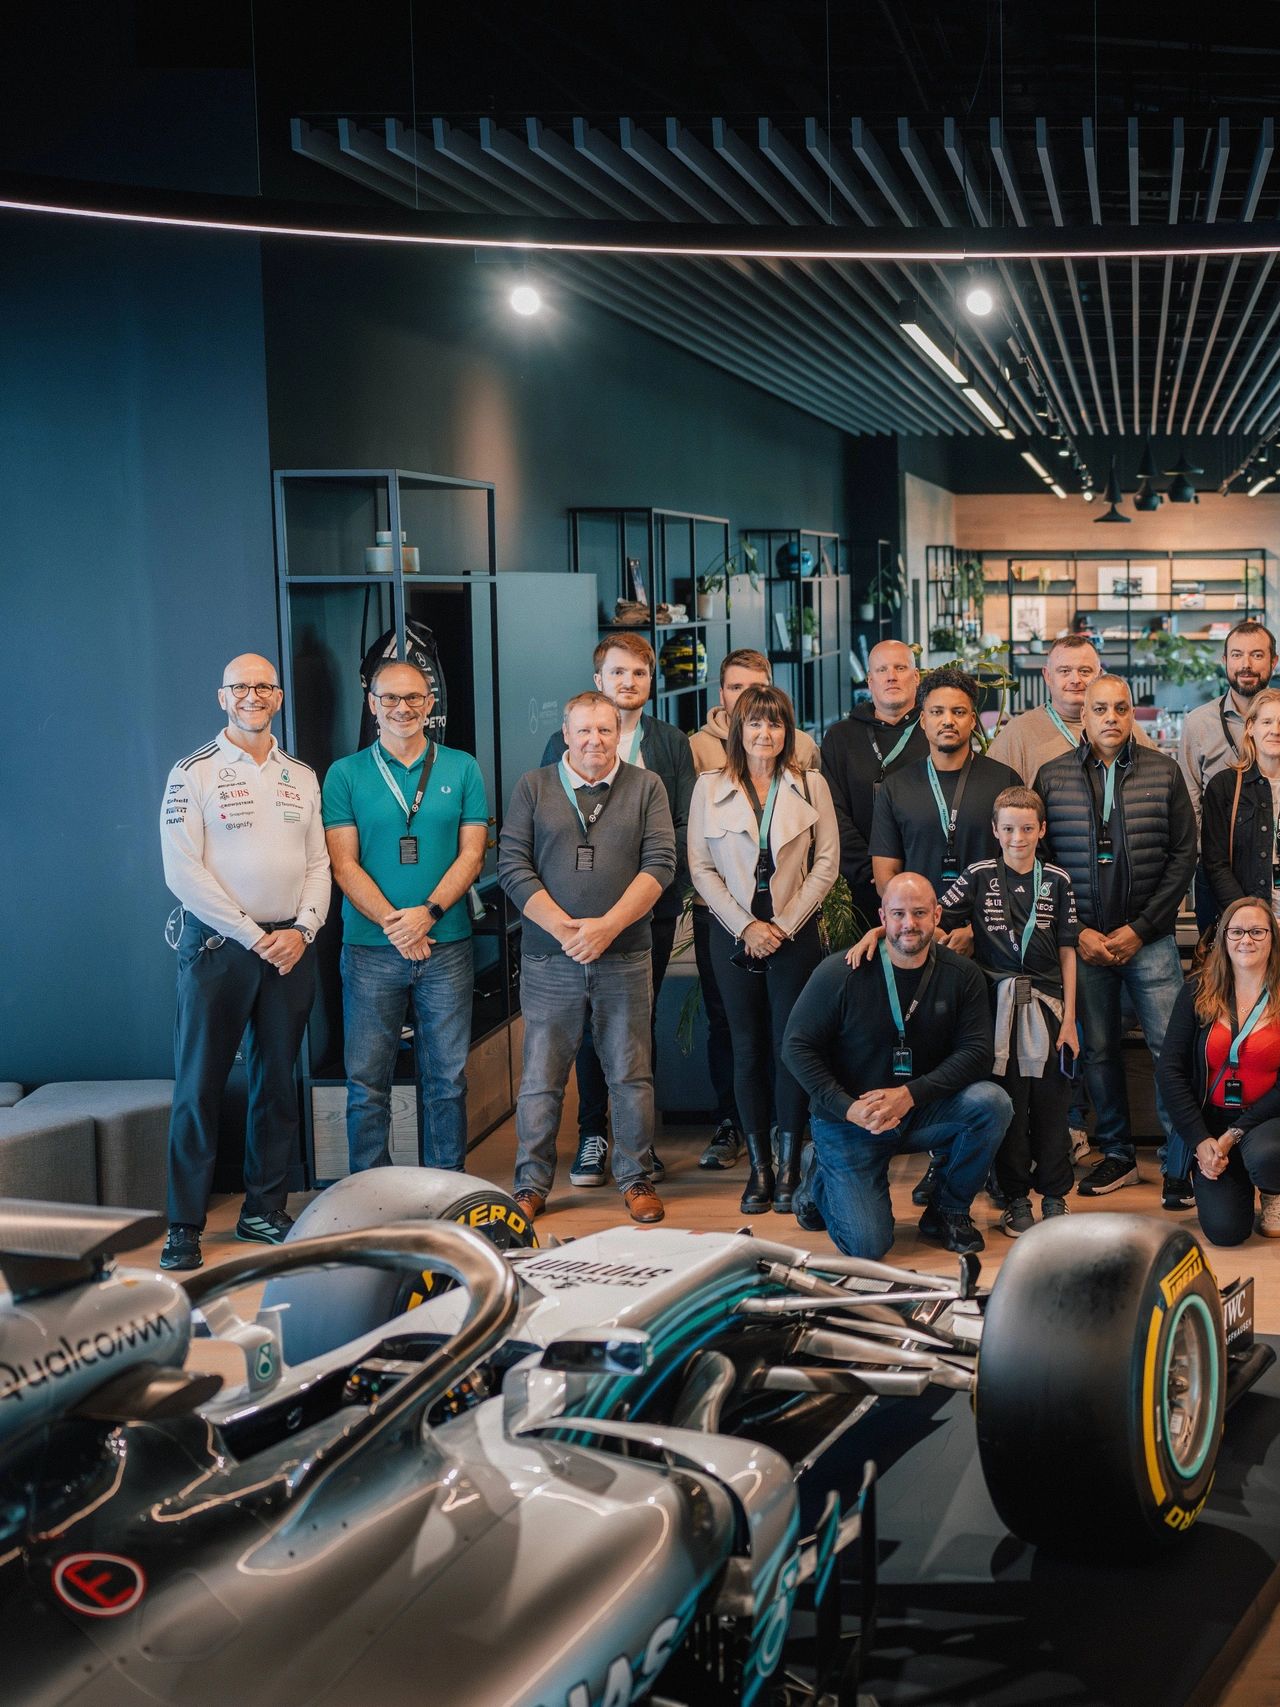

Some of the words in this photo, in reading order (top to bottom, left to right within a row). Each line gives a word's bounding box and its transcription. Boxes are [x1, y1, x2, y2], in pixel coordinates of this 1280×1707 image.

[230, 789, 250, 798] UBS
[276, 789, 301, 801] INEOS
[1159, 1246, 1204, 1309] PIRELLI
[1224, 1288, 1246, 1331] IWC
[63, 1560, 134, 1608] E
